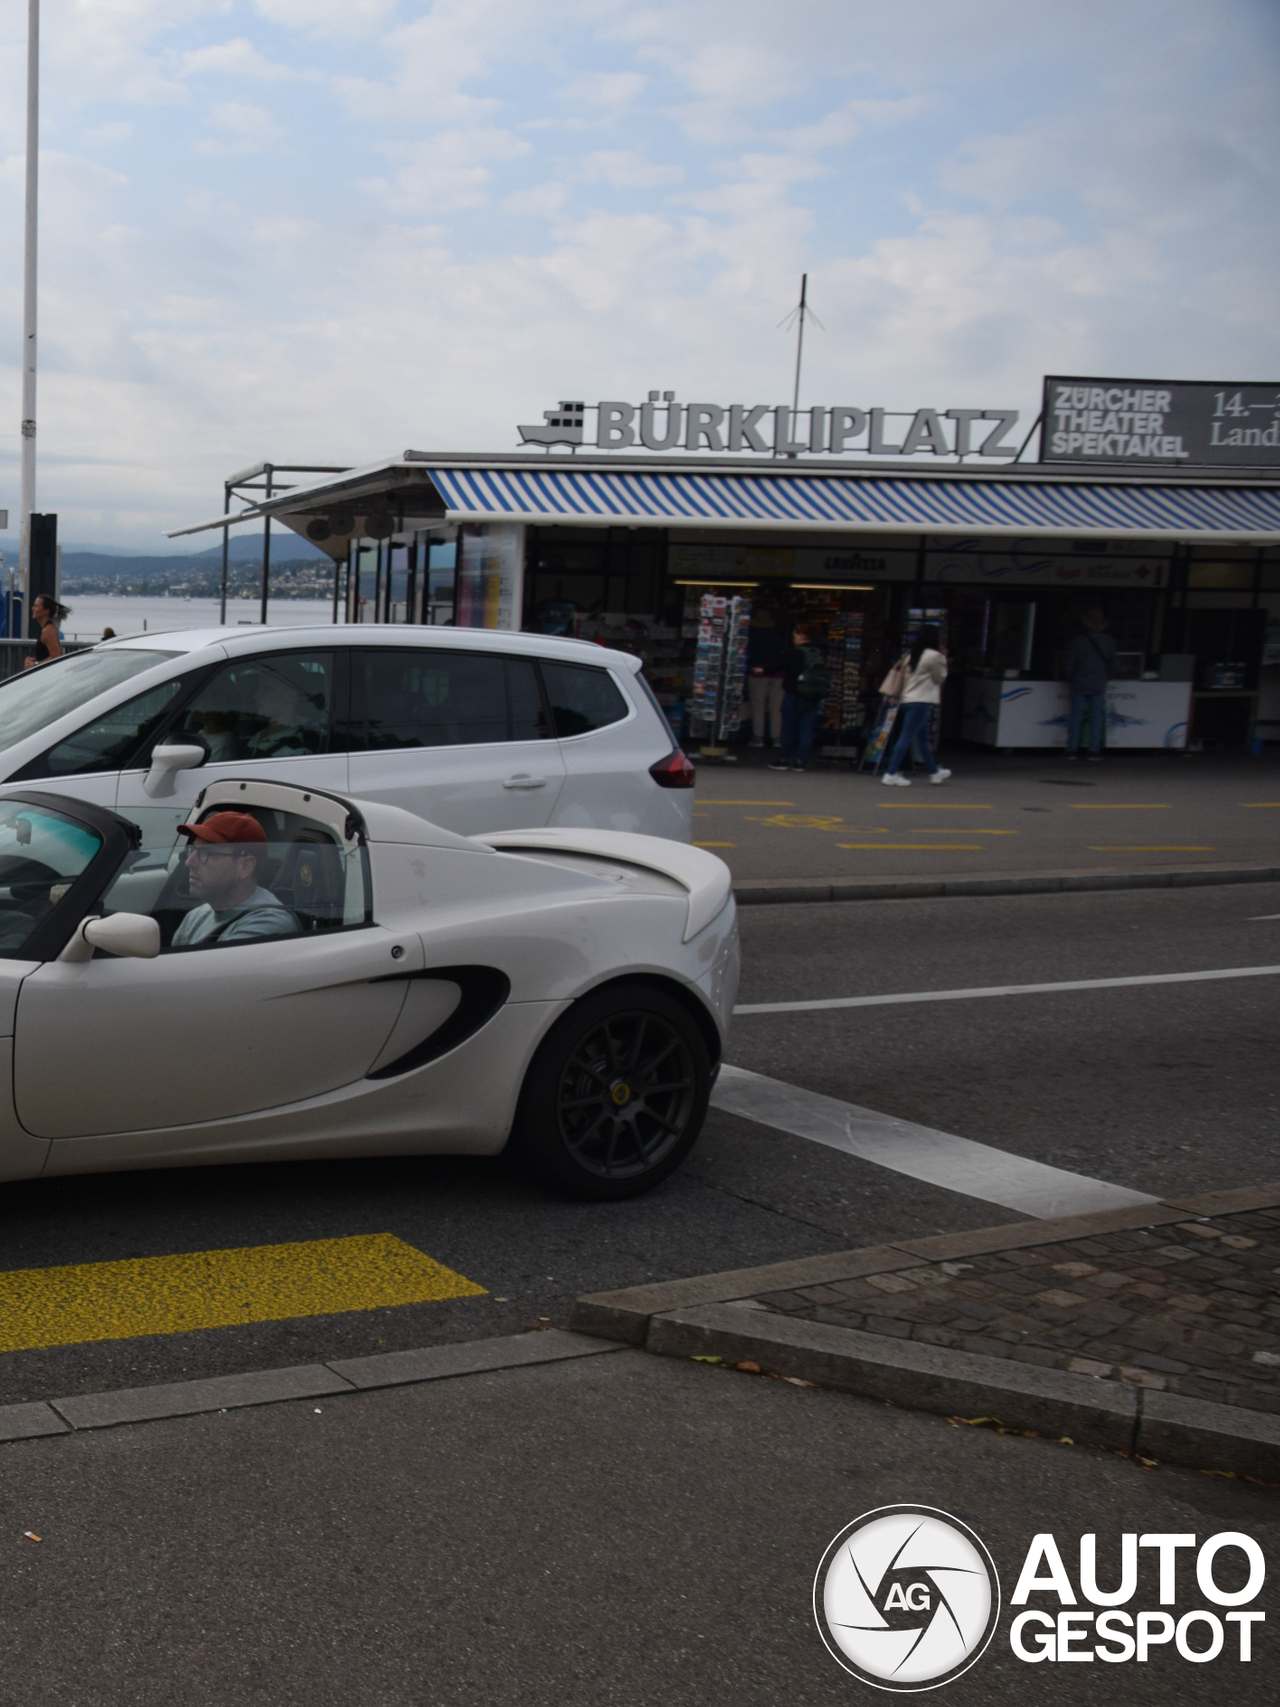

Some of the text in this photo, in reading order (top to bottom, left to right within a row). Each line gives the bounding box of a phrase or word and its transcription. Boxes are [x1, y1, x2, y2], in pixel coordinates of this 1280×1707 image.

[1054, 386, 1173, 412] ZÜRCHER
[1212, 391, 1280, 418] 14.—
[596, 389, 1019, 457] BÜRKLIPLATZ
[1053, 409, 1164, 434] THEATER
[1208, 420, 1280, 447] Land
[1051, 432, 1190, 458] SPEKTAKEL
[824, 552, 887, 570] LAVAZZA
